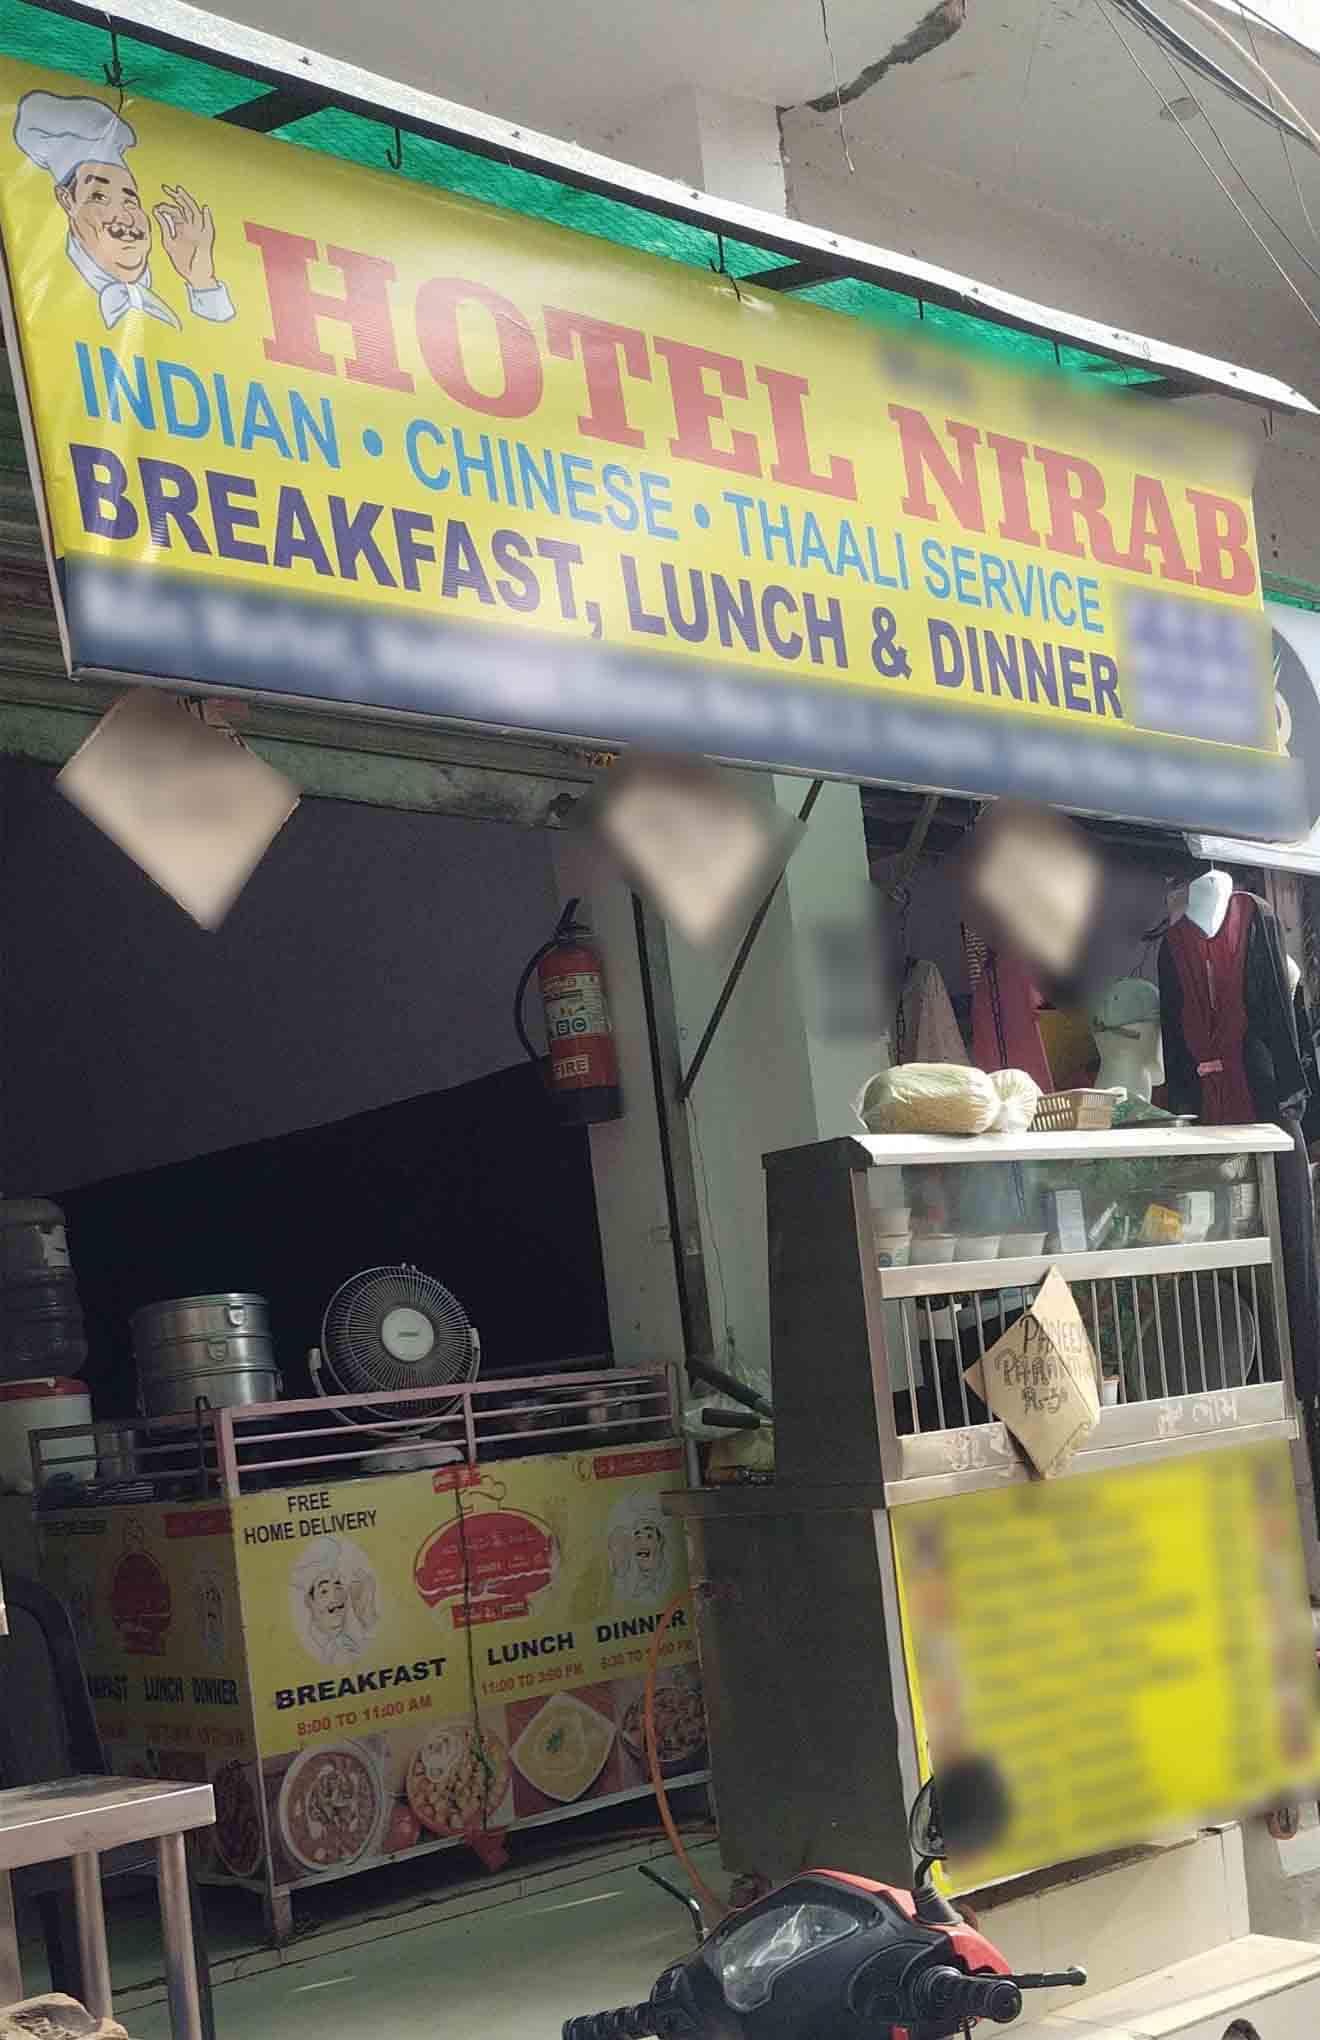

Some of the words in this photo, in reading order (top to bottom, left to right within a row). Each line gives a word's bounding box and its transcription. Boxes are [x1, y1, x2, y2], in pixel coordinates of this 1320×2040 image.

[243, 221, 858, 501] HOTEL
[888, 402, 1257, 597] NIRAB
[75, 340, 342, 469] INDIAN
[406, 419, 679, 542] CHINESE
[722, 491, 909, 592] THAALI
[922, 539, 1105, 634] SERVICE
[70, 443, 603, 640] BREAKFAST,
[621, 553, 849, 669] LUNCH
[869, 606, 912, 680] &
[927, 617, 1124, 719] DINNER
[244, 1521, 294, 1545] HOME
[299, 1510, 377, 1538] DELIVERY
[287, 1491, 331, 1513] FREE
[274, 1657, 447, 1710] BREAKFAST
[487, 1631, 574, 1665] LUNCH
[518, 1673, 534, 1689] TO
[297, 1716, 331, 1736] 8:00
[336, 1711, 358, 1728] TO
[364, 1702, 405, 1721] 11:00
[408, 1695, 432, 1712] AM
